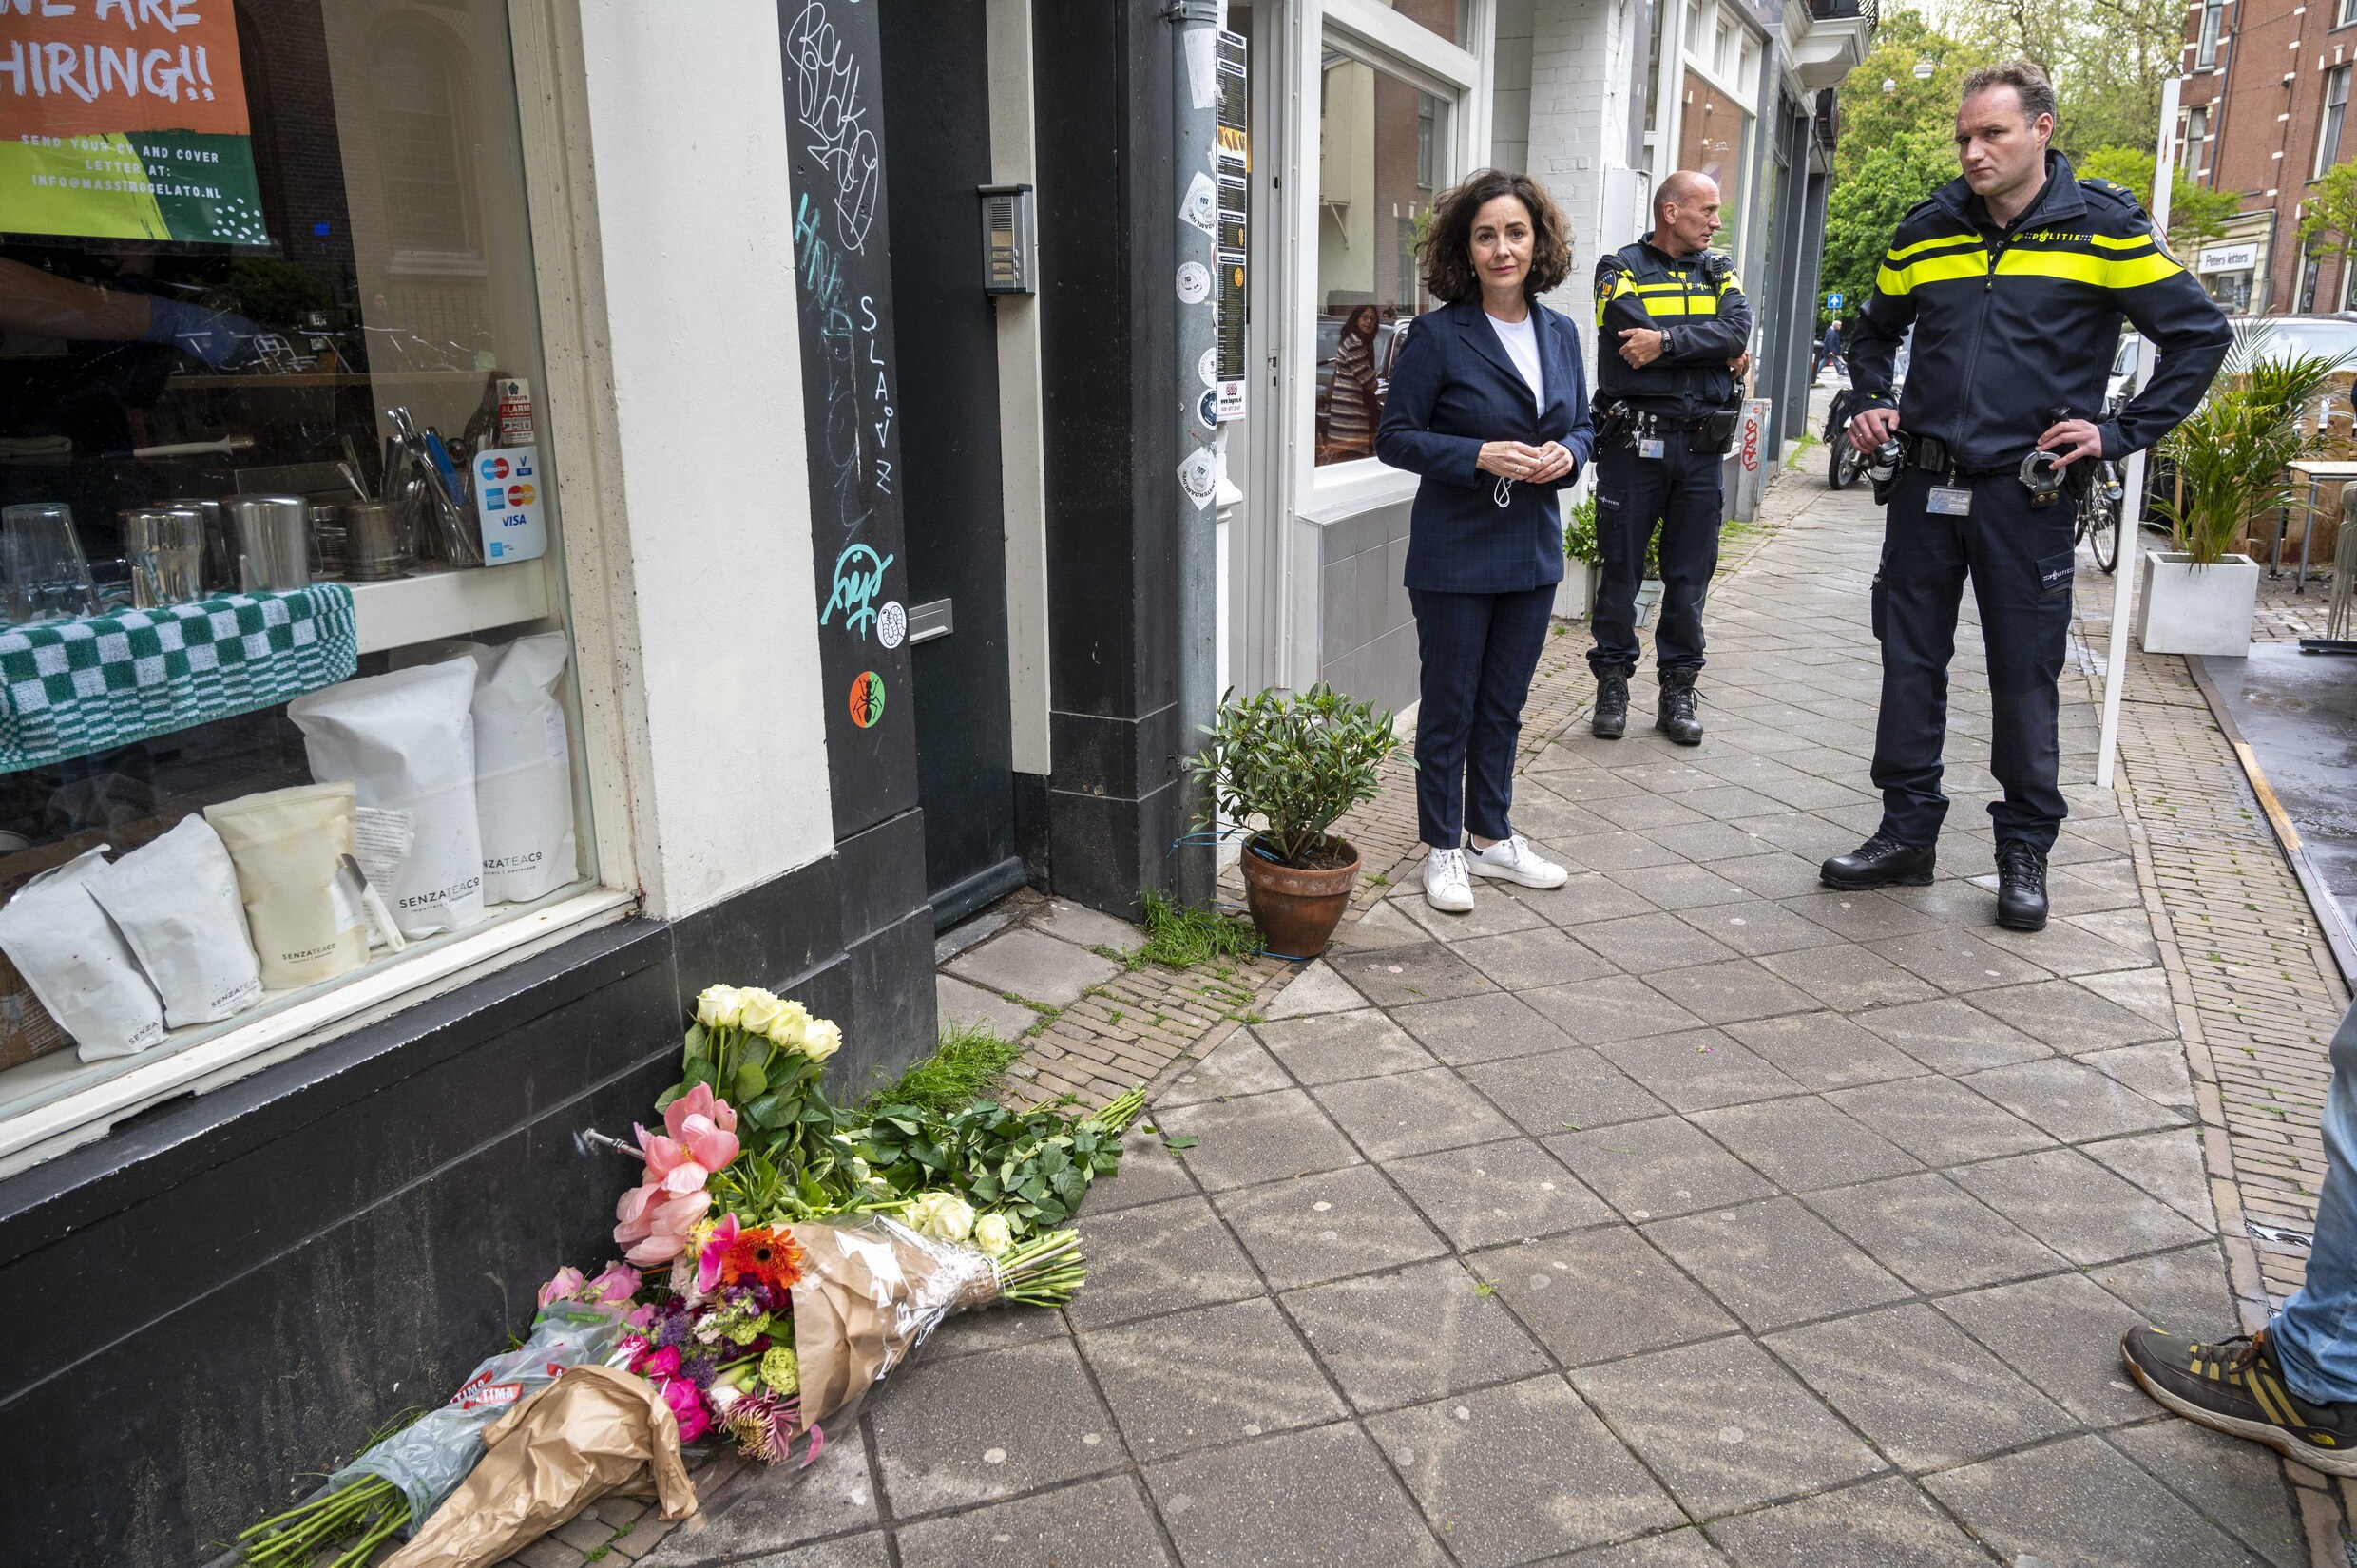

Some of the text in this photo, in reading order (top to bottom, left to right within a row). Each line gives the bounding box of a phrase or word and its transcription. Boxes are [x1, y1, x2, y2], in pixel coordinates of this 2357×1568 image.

[0, 40, 215, 104] HIRING!!
[21, 134, 219, 163] SEND YOUR CV AND COVER
[86, 159, 171, 177] LETTER AT:
[2206, 252, 2249, 267] Peters letters
[502, 404, 531, 413] ALARM
[502, 514, 527, 527] VISA
